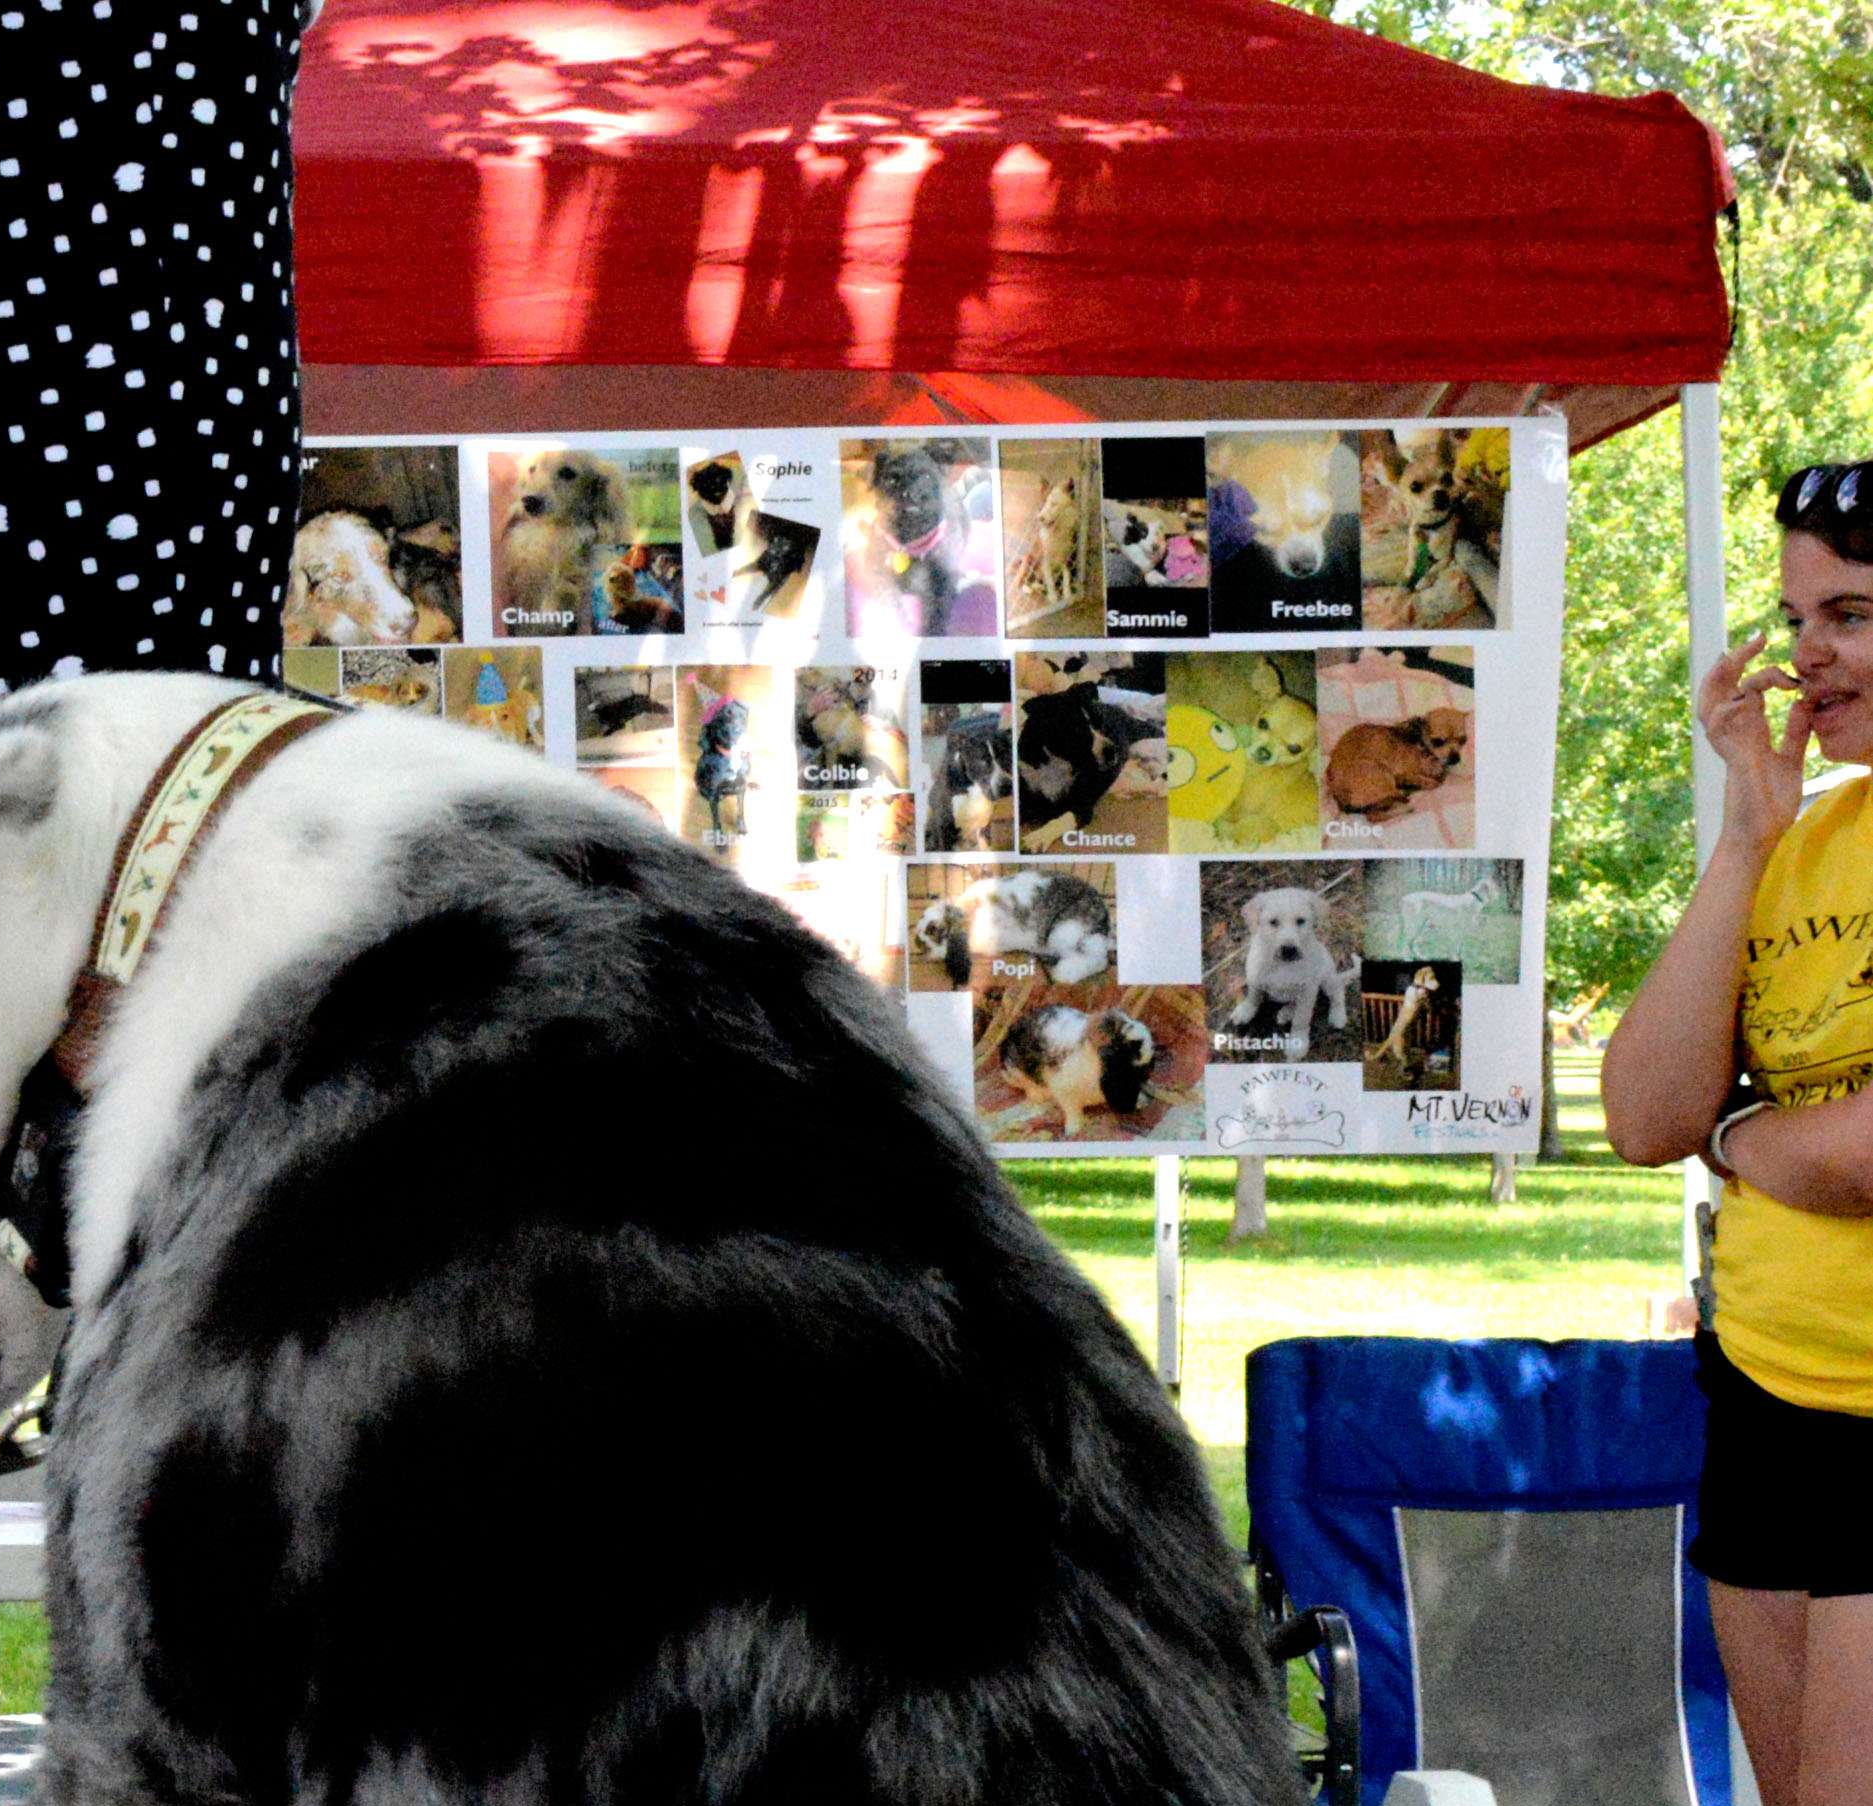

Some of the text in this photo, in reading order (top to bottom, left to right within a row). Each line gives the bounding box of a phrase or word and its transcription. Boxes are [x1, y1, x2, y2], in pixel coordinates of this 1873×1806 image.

[756, 459, 813, 480] Sophie
[501, 607, 574, 627] Champ
[1271, 600, 1353, 619] Freebee
[1106, 609, 1188, 629] Sammie
[854, 668, 898, 683] 2014
[803, 764, 870, 782] Colbie
[1063, 830, 1136, 846] Chance
[1325, 821, 1383, 838] Chloe
[993, 960, 1035, 978] Popi
[1213, 1033, 1304, 1051] Pistachio
[1240, 1069, 1325, 1094] PAWFEST
[1407, 1094, 1448, 1123] MT.
